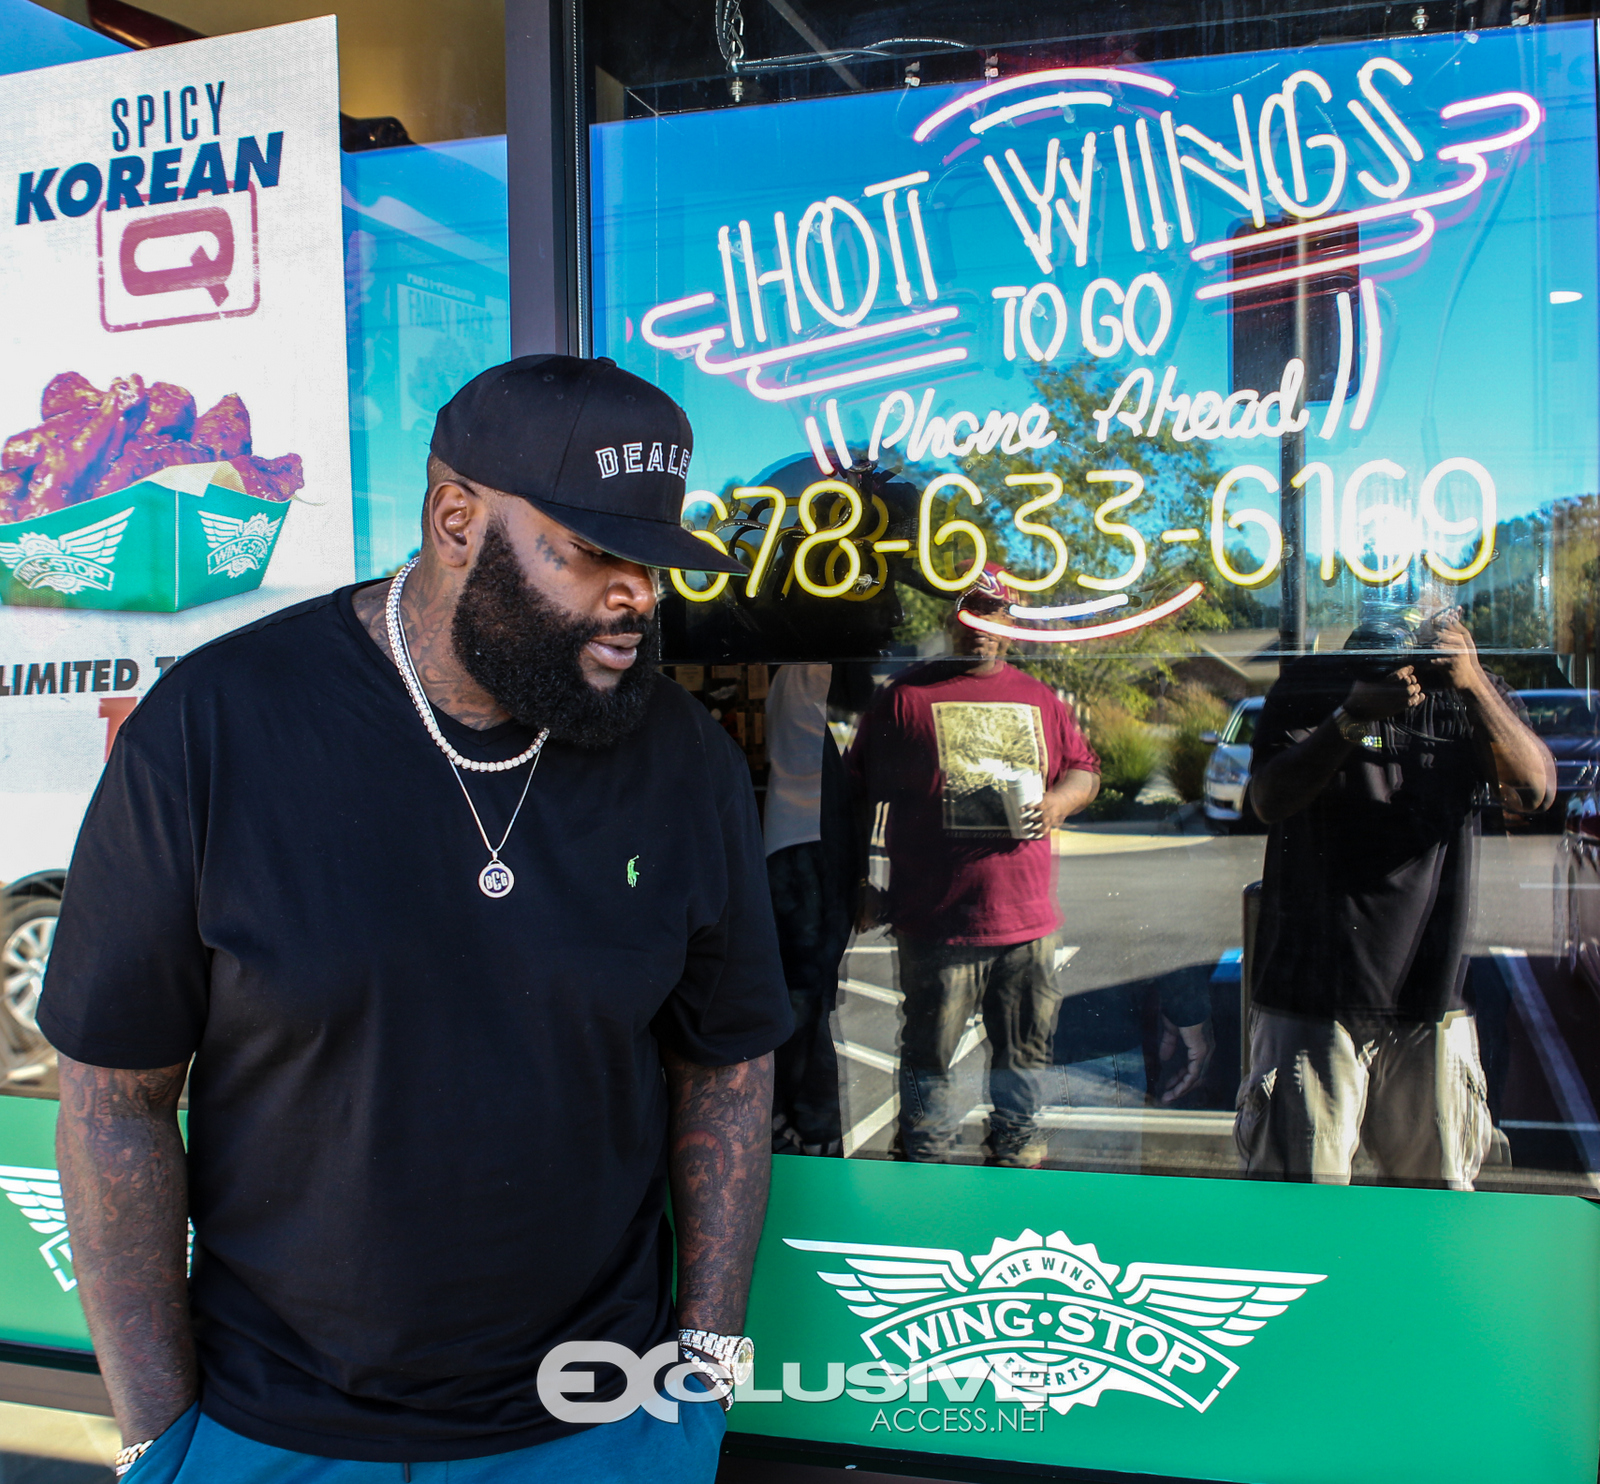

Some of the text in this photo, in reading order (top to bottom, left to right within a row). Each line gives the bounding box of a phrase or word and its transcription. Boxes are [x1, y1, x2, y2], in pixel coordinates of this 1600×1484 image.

[111, 80, 226, 152] SPICY
[15, 131, 285, 226] KOREAN
[718, 56, 1425, 348] HOT WINGS
[119, 206, 235, 308] Q
[991, 271, 1172, 362] TO GO
[867, 358, 1310, 463] Phone Ahead
[0, 658, 140, 696] LIMITED
[996, 1256, 1096, 1291] THE WING
[1002, 1356, 1091, 1386] EXPERTS
